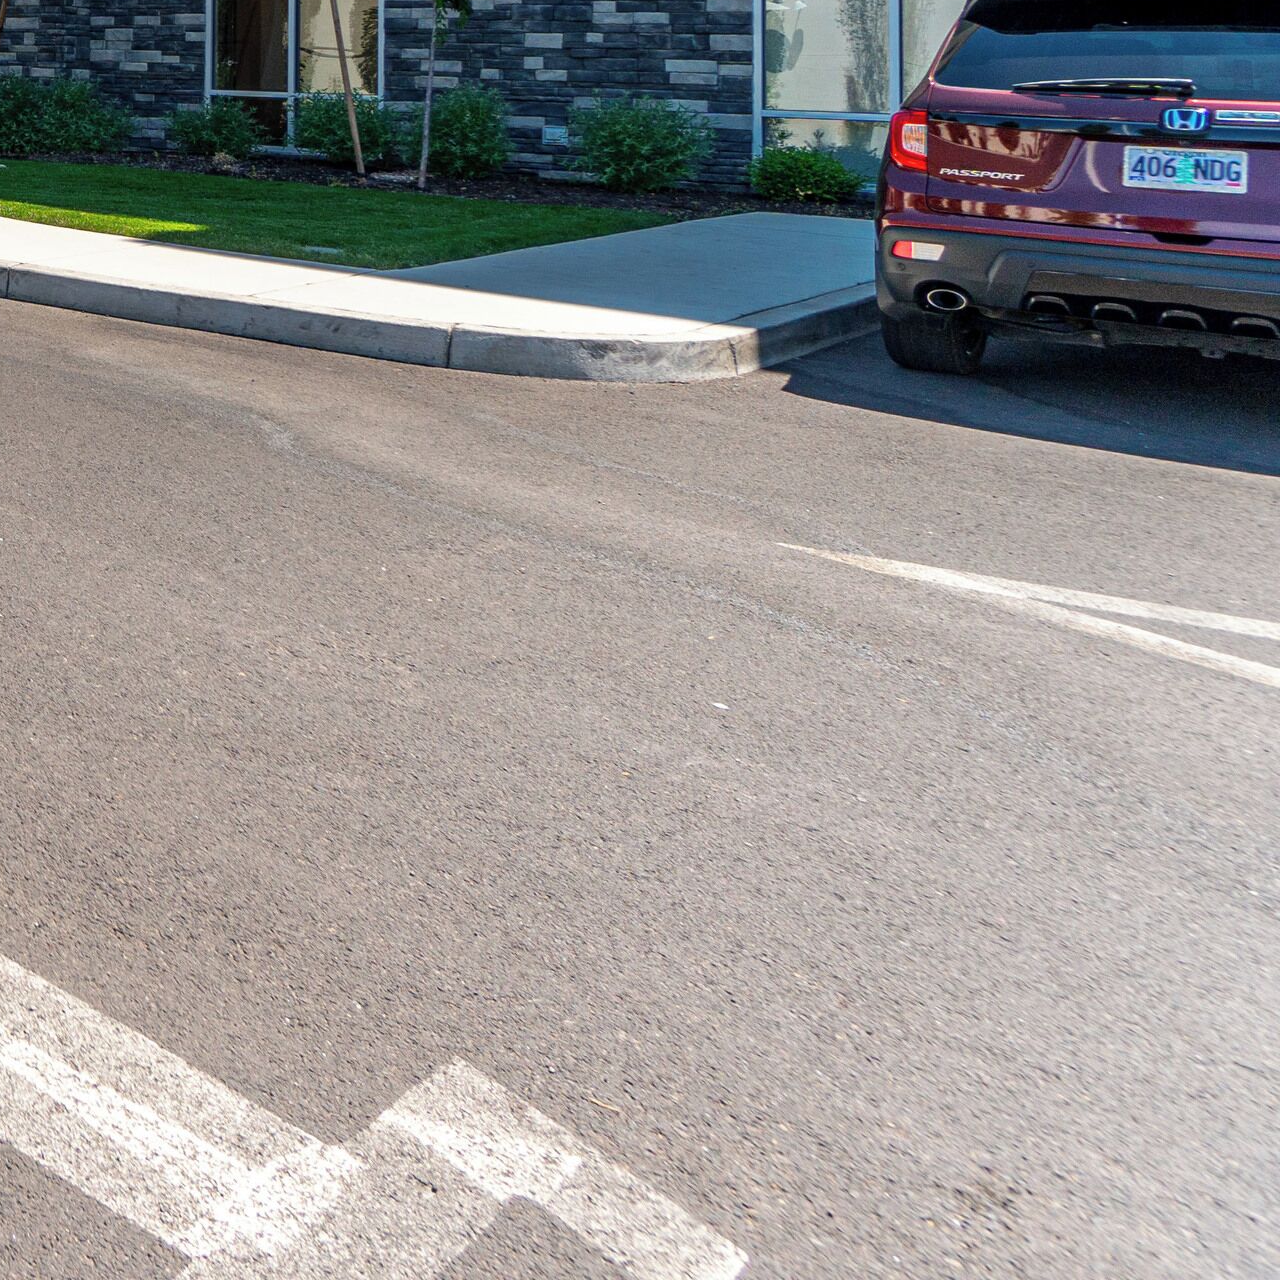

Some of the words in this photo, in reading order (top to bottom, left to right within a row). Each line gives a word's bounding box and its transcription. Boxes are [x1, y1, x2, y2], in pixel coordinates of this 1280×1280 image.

[939, 167, 1025, 181] PASSPORT
[1131, 155, 1177, 178] 406
[1194, 158, 1242, 182] NDG
